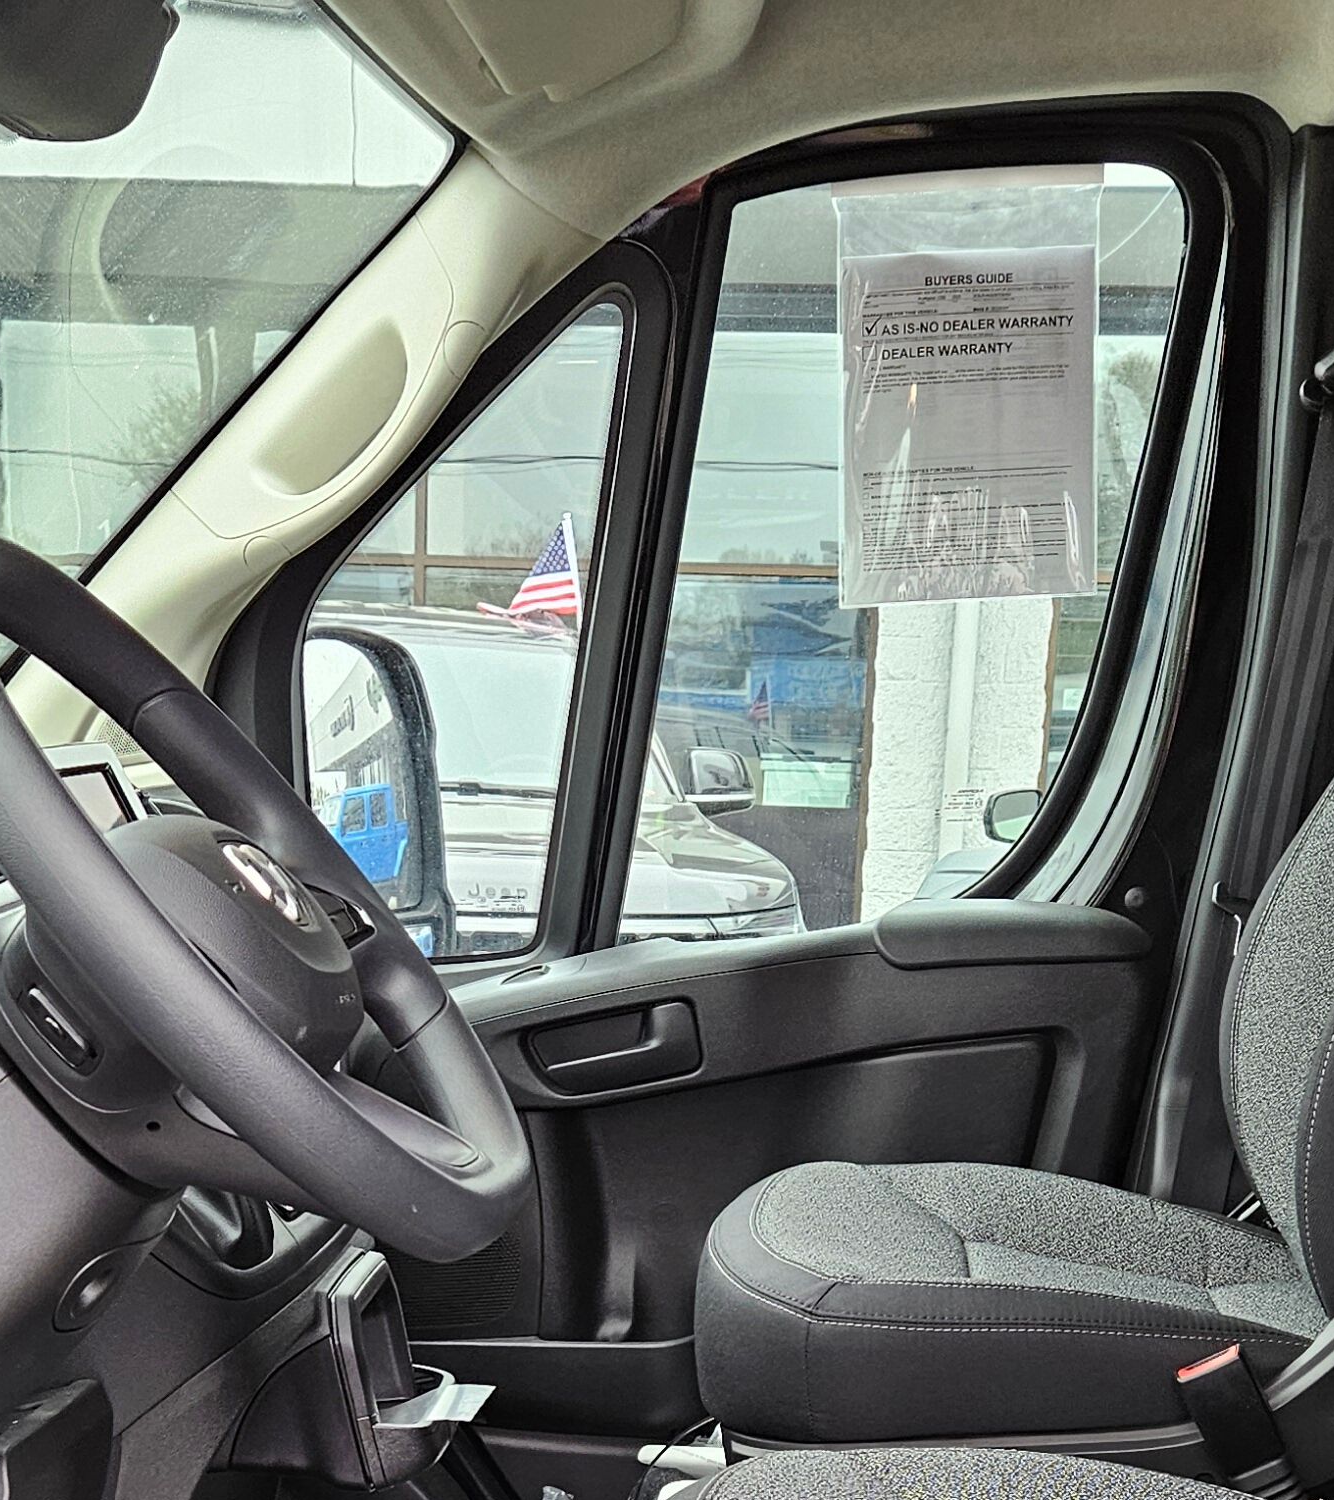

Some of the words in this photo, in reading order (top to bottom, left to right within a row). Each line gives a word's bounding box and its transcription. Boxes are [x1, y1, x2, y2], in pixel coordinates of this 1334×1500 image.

[925, 274, 973, 287] BUYERS
[976, 272, 1014, 285] GUIDE
[882, 324, 899, 336] AS
[903, 321, 939, 335] IS-NO
[943, 318, 995, 333] DEALER
[999, 315, 1074, 329] WARRANTY
[881, 346, 935, 360] DEALER
[937, 342, 1013, 358] WARRANTY
